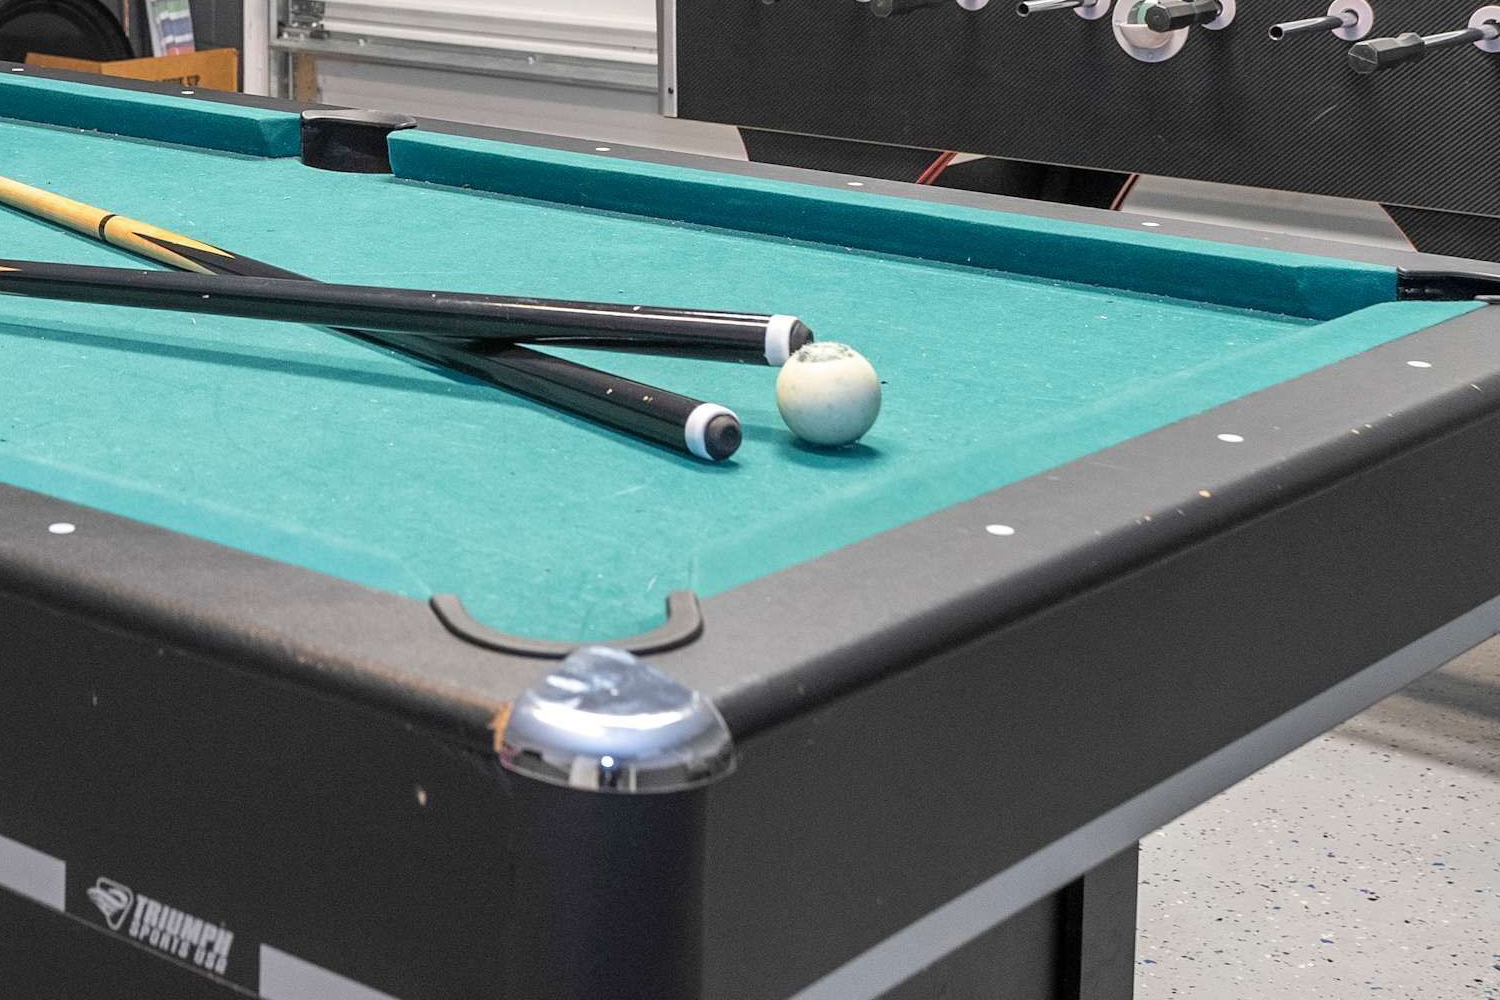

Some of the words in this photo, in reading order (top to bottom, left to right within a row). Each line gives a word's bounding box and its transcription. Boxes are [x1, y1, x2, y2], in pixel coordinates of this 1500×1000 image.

[129, 919, 190, 959] SPORTS
[193, 945, 228, 975] USA
[133, 893, 235, 956] TRIUMPH
